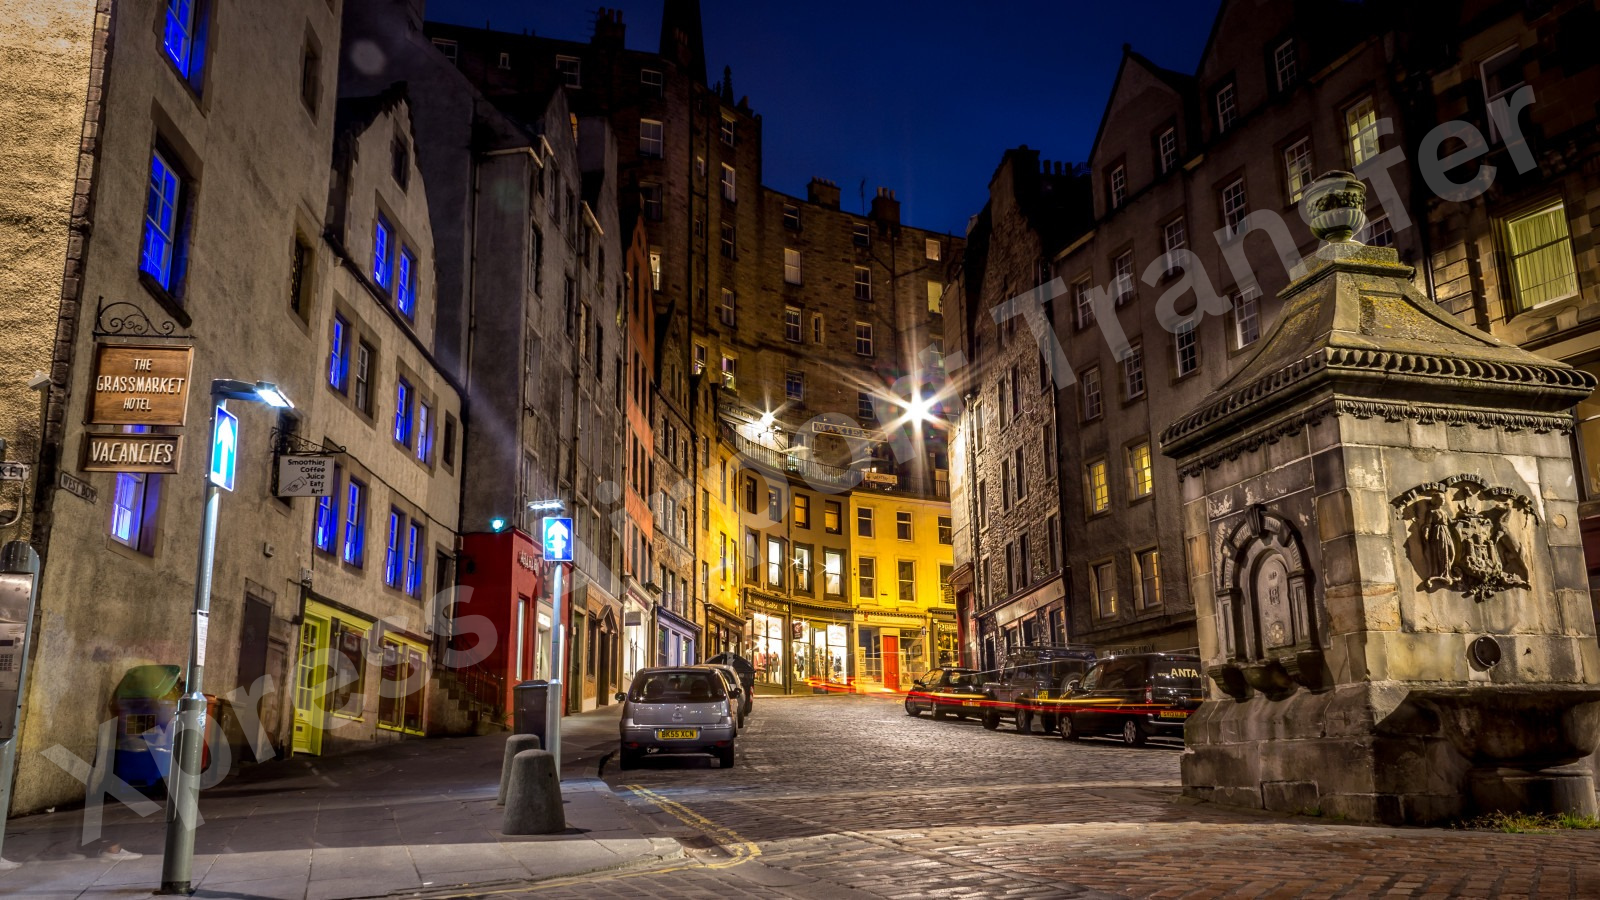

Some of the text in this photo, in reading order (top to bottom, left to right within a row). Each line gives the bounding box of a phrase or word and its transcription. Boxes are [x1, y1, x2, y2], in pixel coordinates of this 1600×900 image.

[134, 358, 152, 371] THE
[96, 375, 184, 393] GRASSMARKET
[123, 397, 152, 410] HOTEL
[92, 441, 173, 463] VACANCIES
[63, 475, 80, 493] WEST
